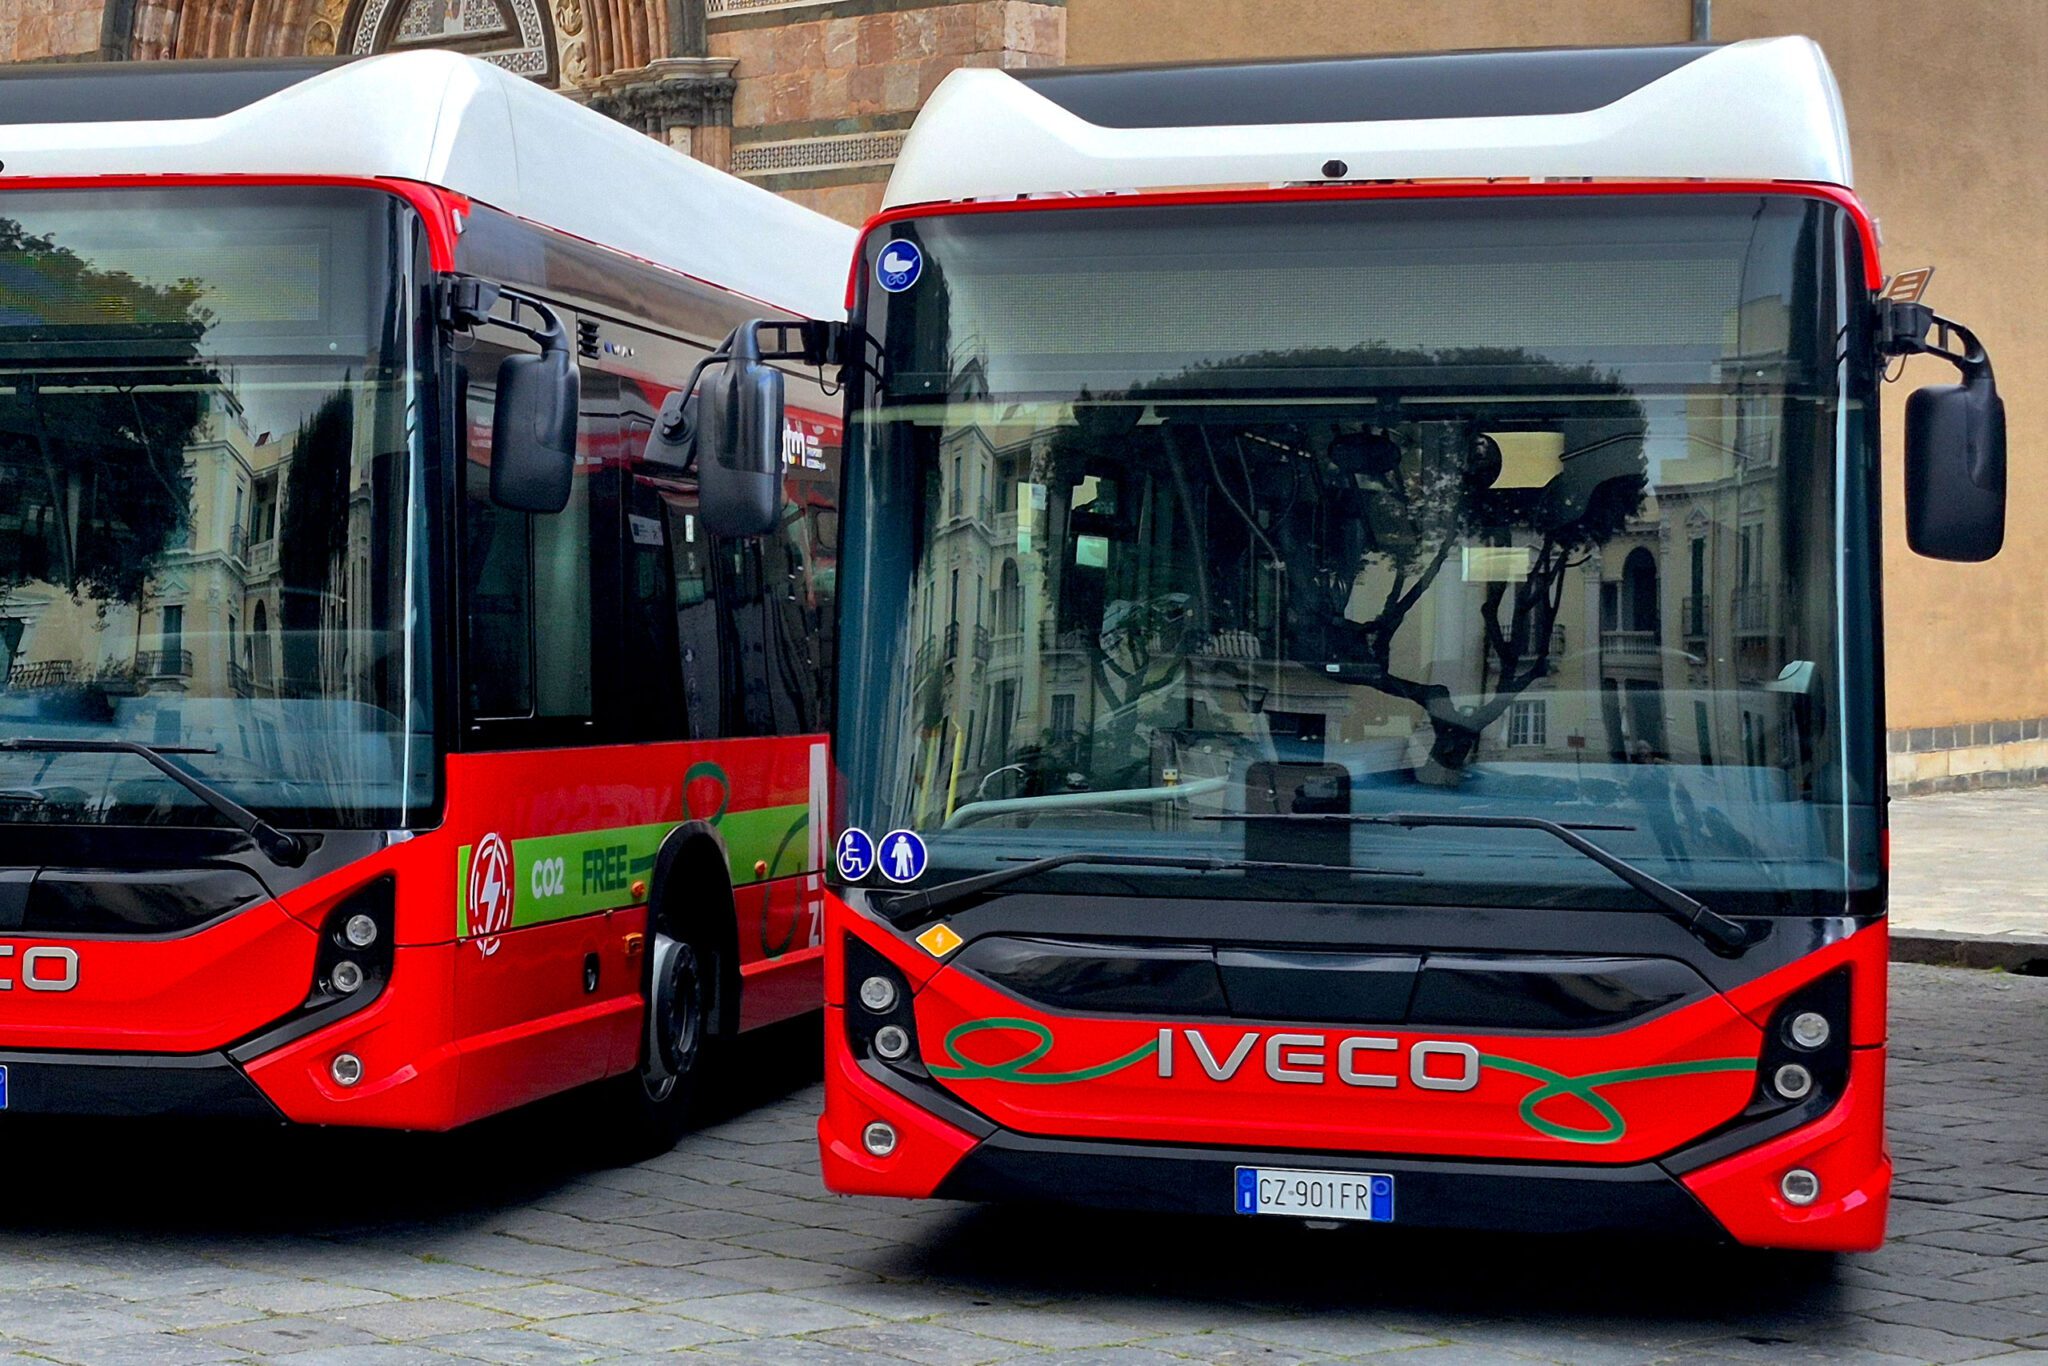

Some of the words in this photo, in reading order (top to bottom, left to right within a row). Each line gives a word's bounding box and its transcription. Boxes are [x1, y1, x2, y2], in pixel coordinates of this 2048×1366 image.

[531, 857, 564, 900] CO2
[583, 844, 628, 896] FREE
[1158, 1028, 1480, 1092] IVECO
